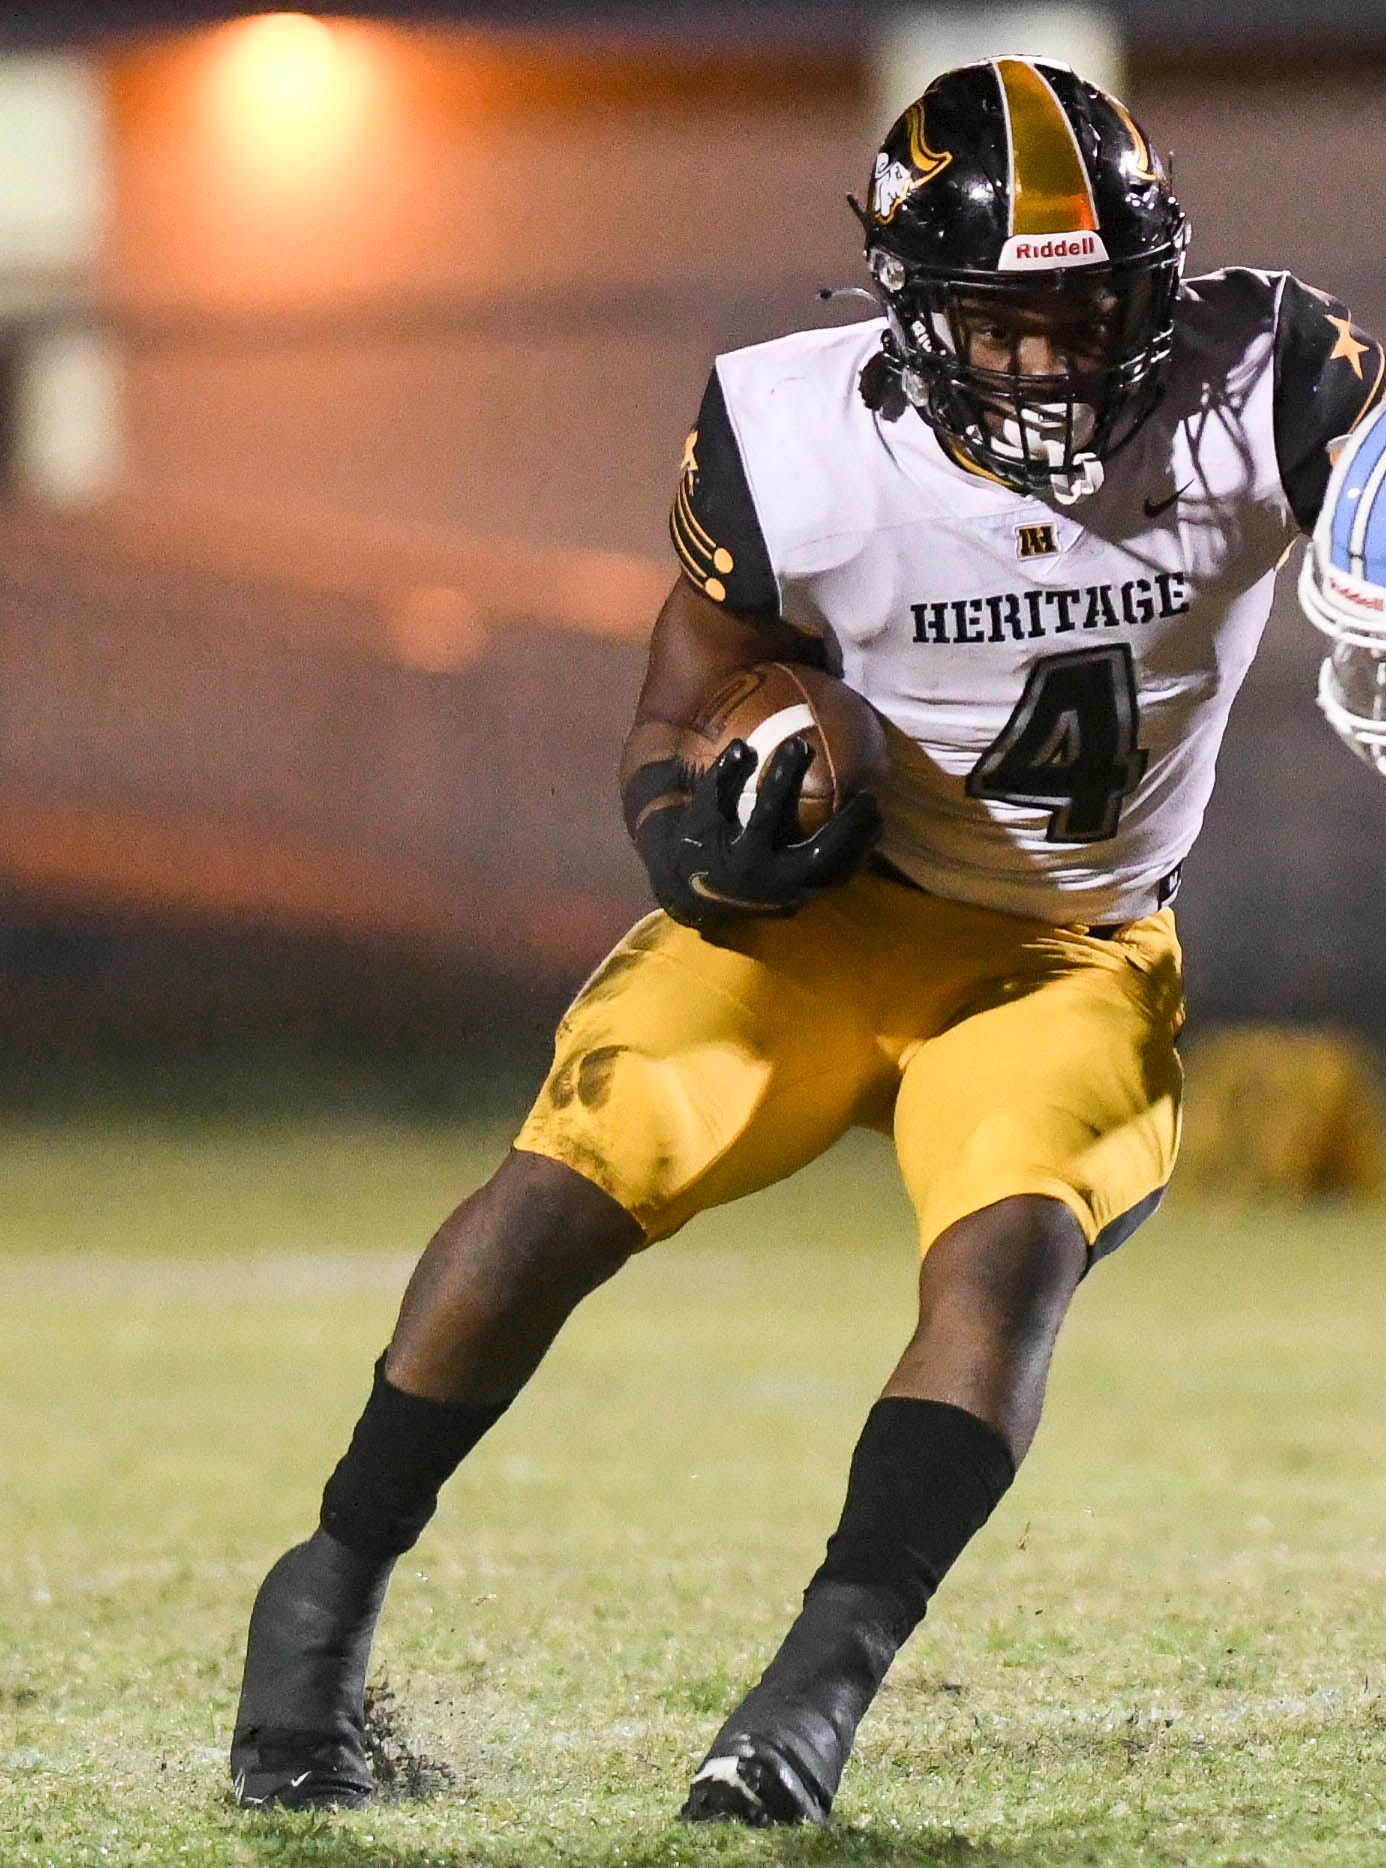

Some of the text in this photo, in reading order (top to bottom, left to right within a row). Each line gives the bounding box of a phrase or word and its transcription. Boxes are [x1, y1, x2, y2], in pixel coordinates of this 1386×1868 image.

[1015, 237, 1095, 260] Riddell
[910, 571, 1190, 644] HERITAGE
[964, 642, 1150, 844] 4
